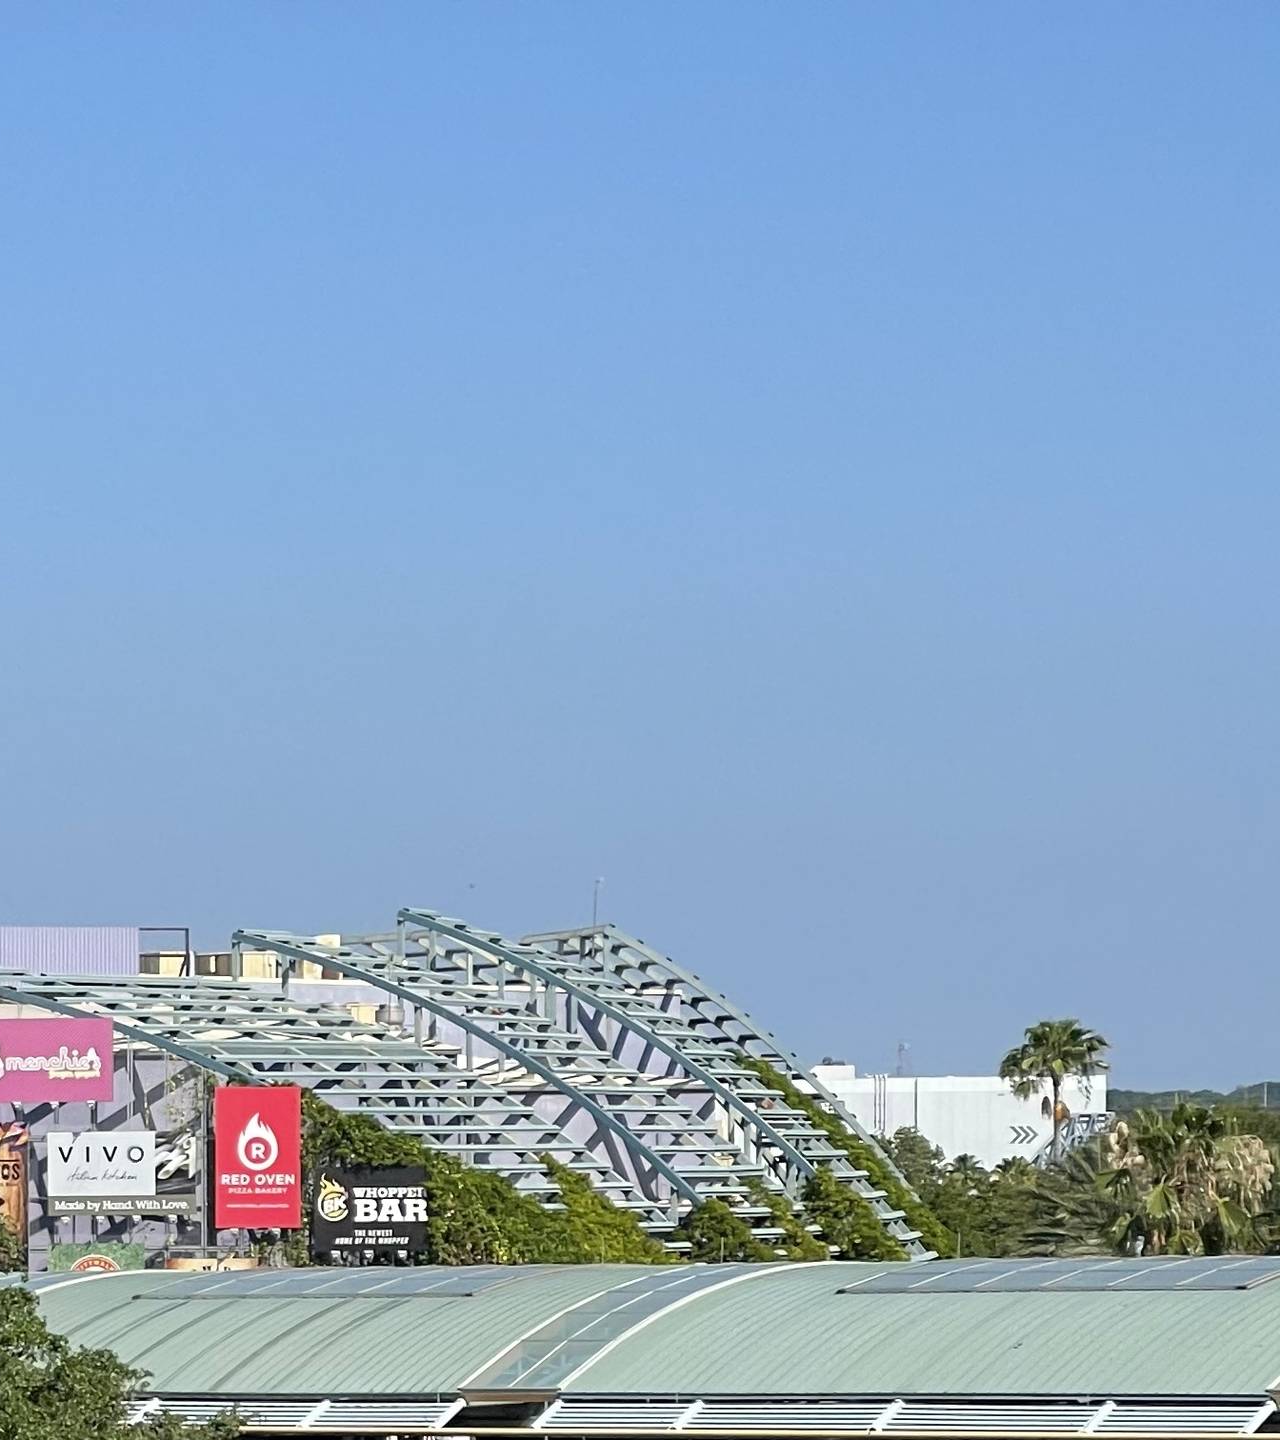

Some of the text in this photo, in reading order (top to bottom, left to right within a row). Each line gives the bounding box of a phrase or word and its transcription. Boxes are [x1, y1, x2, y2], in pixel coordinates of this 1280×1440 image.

[5, 1046, 101, 1071] menchie's
[58, 1146, 145, 1164] VIVO
[251, 1143, 265, 1160] R
[221, 1174, 296, 1185] RED OVEN
[55, 1200, 190, 1212] Made by Hand. With Love.
[322, 1195, 347, 1214] BK
[354, 1198, 429, 1222] BAR
